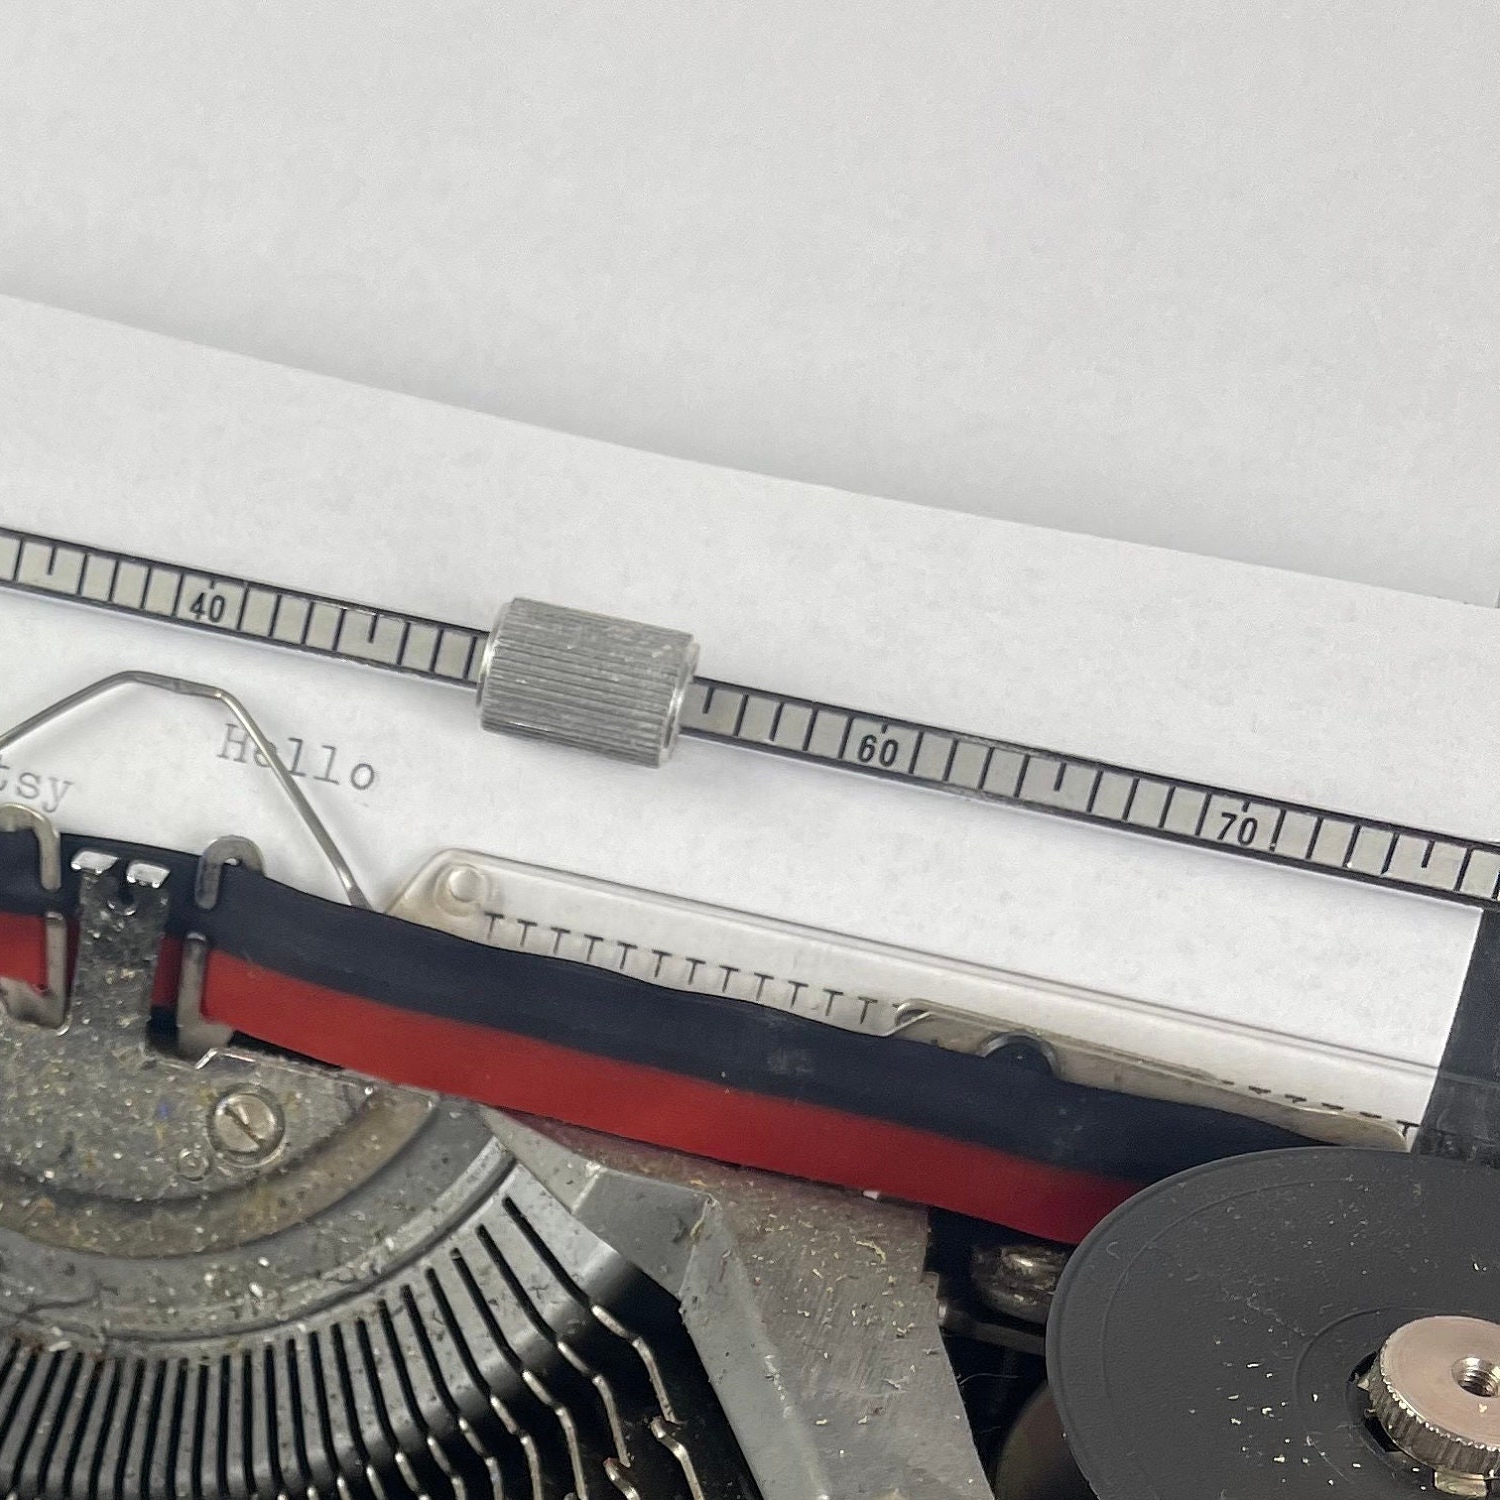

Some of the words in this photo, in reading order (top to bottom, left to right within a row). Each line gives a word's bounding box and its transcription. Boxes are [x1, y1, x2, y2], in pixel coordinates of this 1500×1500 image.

[189, 592, 226, 624] 40
[857, 734, 899, 768] 60
[1217, 812, 1260, 846] 70
